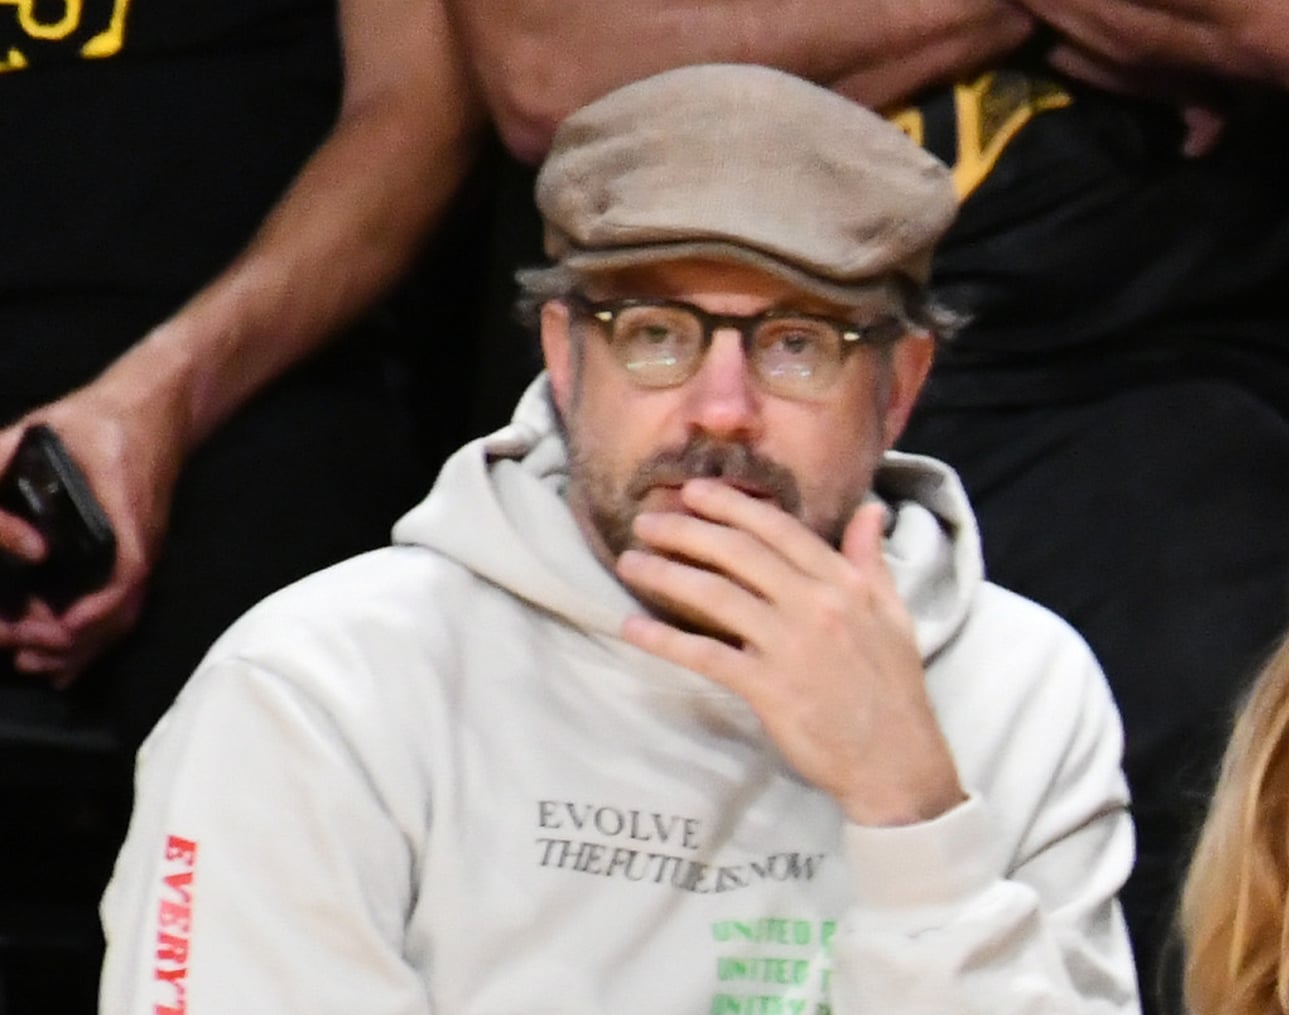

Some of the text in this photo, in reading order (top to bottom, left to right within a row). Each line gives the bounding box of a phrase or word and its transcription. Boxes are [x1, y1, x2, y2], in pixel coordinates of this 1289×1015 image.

[537, 800, 701, 850] EVOLVE
[536, 838, 602, 878] THE
[714, 864, 748, 893] IS
[750, 852, 824, 883] NOW
[711, 916, 812, 946] UNITED
